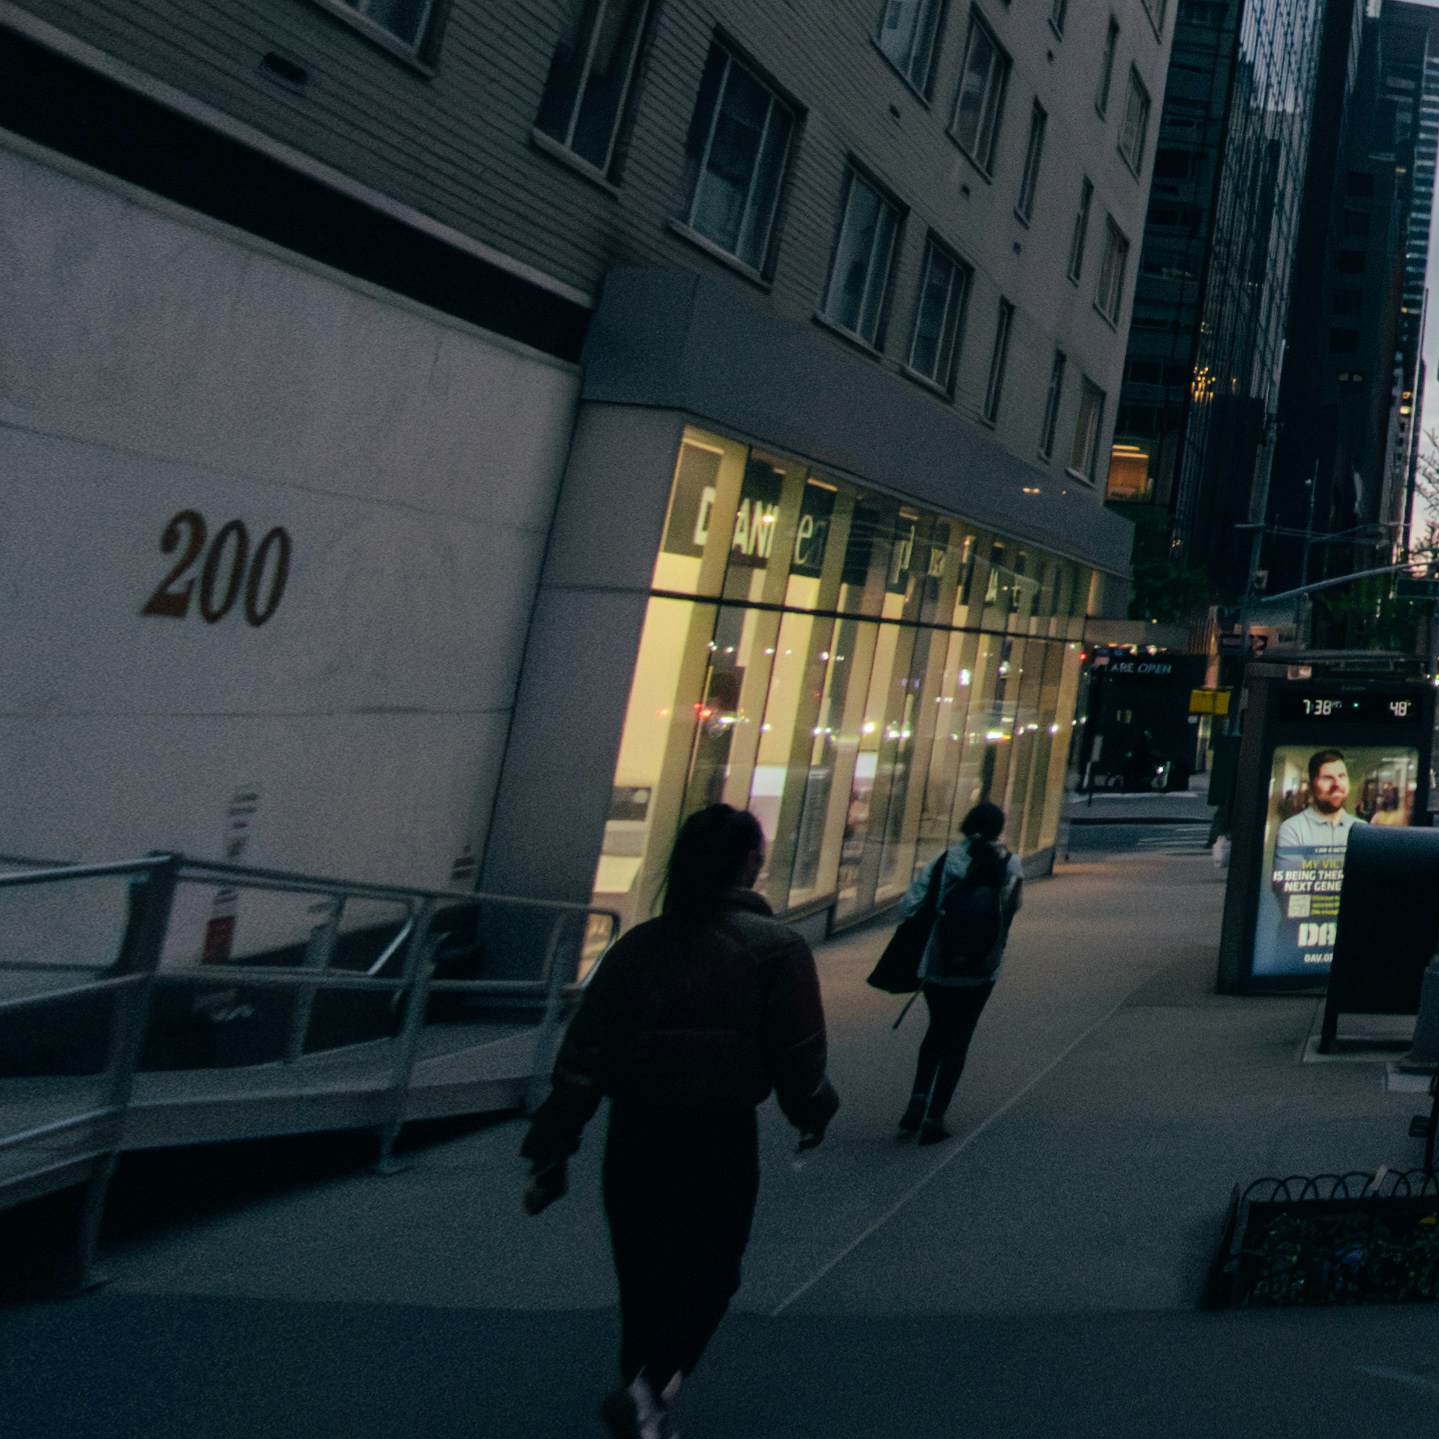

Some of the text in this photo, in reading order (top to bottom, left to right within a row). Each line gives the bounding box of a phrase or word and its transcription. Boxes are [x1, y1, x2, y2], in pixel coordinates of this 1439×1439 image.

[140, 508, 293, 628] 200
[1137, 663, 1173, 674] OPEN
[1273, 870, 1344, 881] IS BEING THER
[1284, 881, 1342, 892] NEXT GENE
